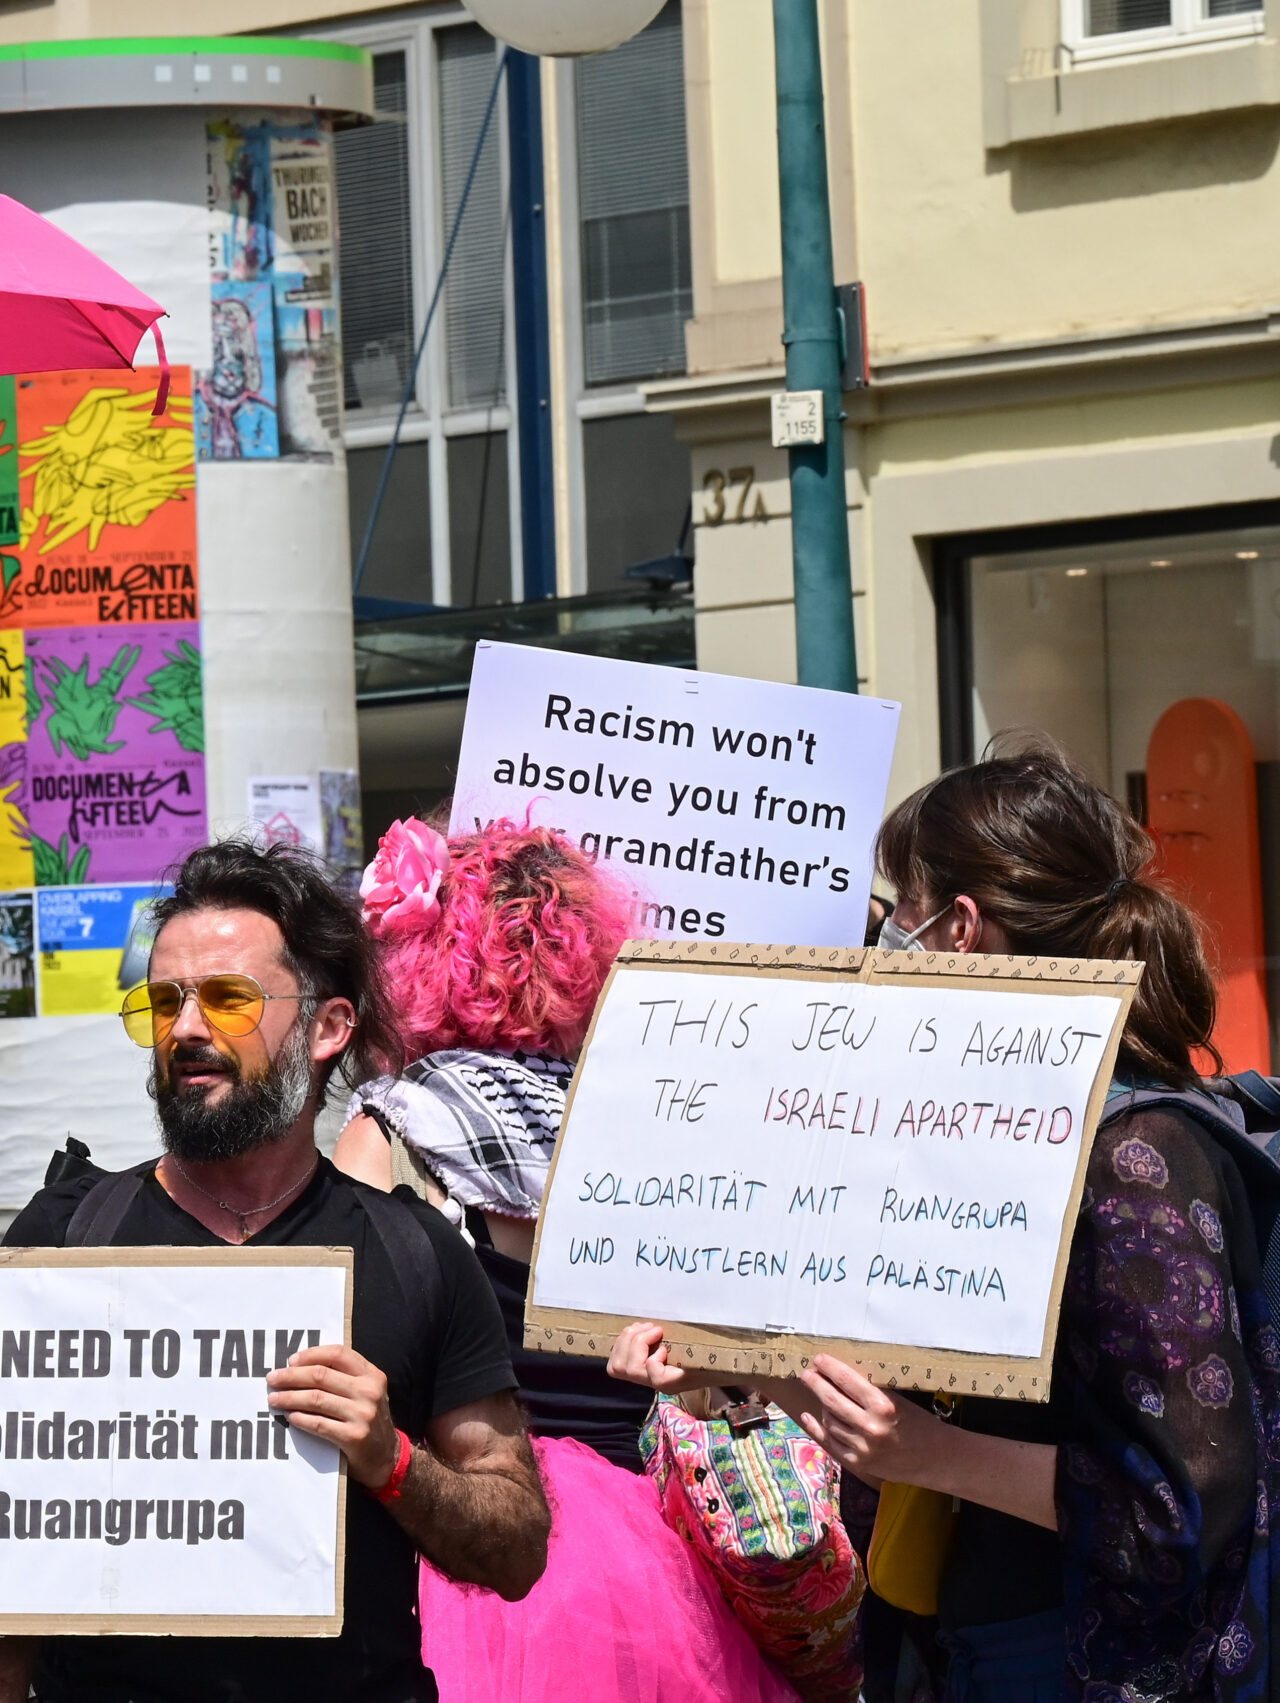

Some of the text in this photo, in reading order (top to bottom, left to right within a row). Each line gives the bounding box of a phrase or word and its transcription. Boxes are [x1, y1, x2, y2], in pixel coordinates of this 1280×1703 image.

[786, 420, 816, 435] 1155
[808, 402, 816, 416] 2
[544, 694, 817, 765] Racism won't
[493, 752, 846, 830] absolve you from
[580, 830, 850, 892] grandfather's
[79, 917, 94, 937] 7
[639, 1000, 758, 1049] THIS
[792, 1001, 876, 1051] JEW
[909, 1018, 937, 1054] IS
[655, 1079, 1072, 1145] THE ISRAELI APARTHEID
[579, 1171, 1027, 1231] SOLIDARITÄT MIT RUANGRUPA
[569, 1235, 1006, 1301] UND KÜNSTLERN AUS PALÄSTINA
[1, 1330, 111, 1378] NEED
[123, 1329, 181, 1378] TO
[210, 1411, 289, 1460] mit
